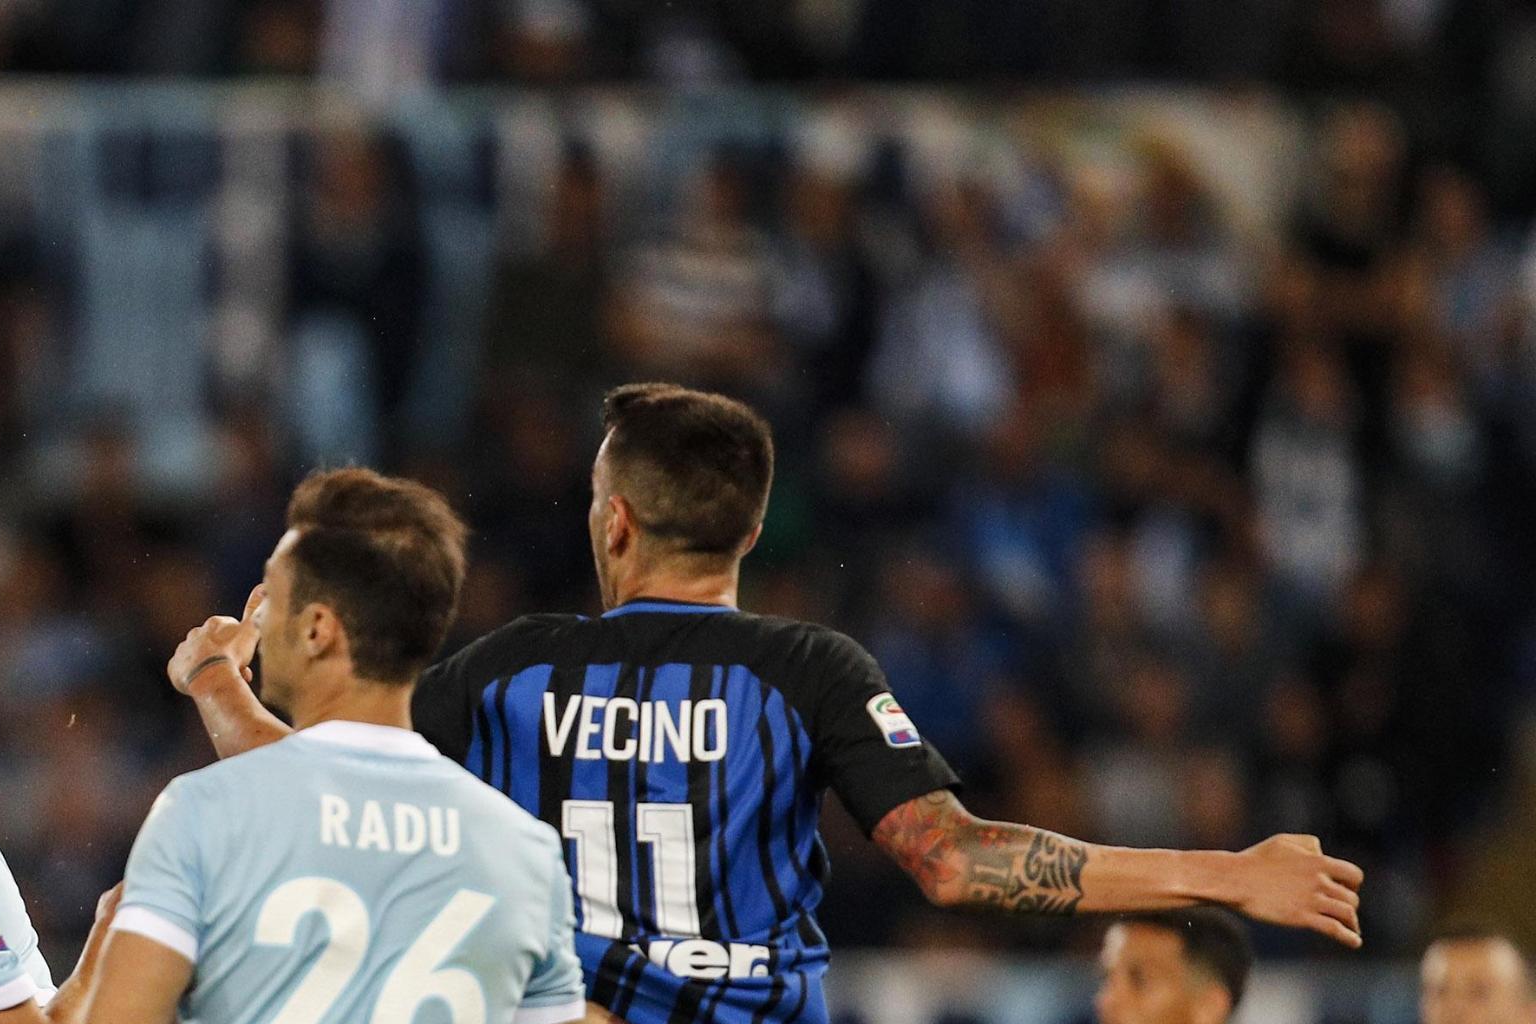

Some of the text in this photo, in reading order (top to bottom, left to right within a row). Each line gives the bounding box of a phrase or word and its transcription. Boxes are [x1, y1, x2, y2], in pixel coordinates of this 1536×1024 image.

[543, 692, 728, 763] VECINO
[319, 794, 462, 857] RADU
[562, 799, 702, 940] 11
